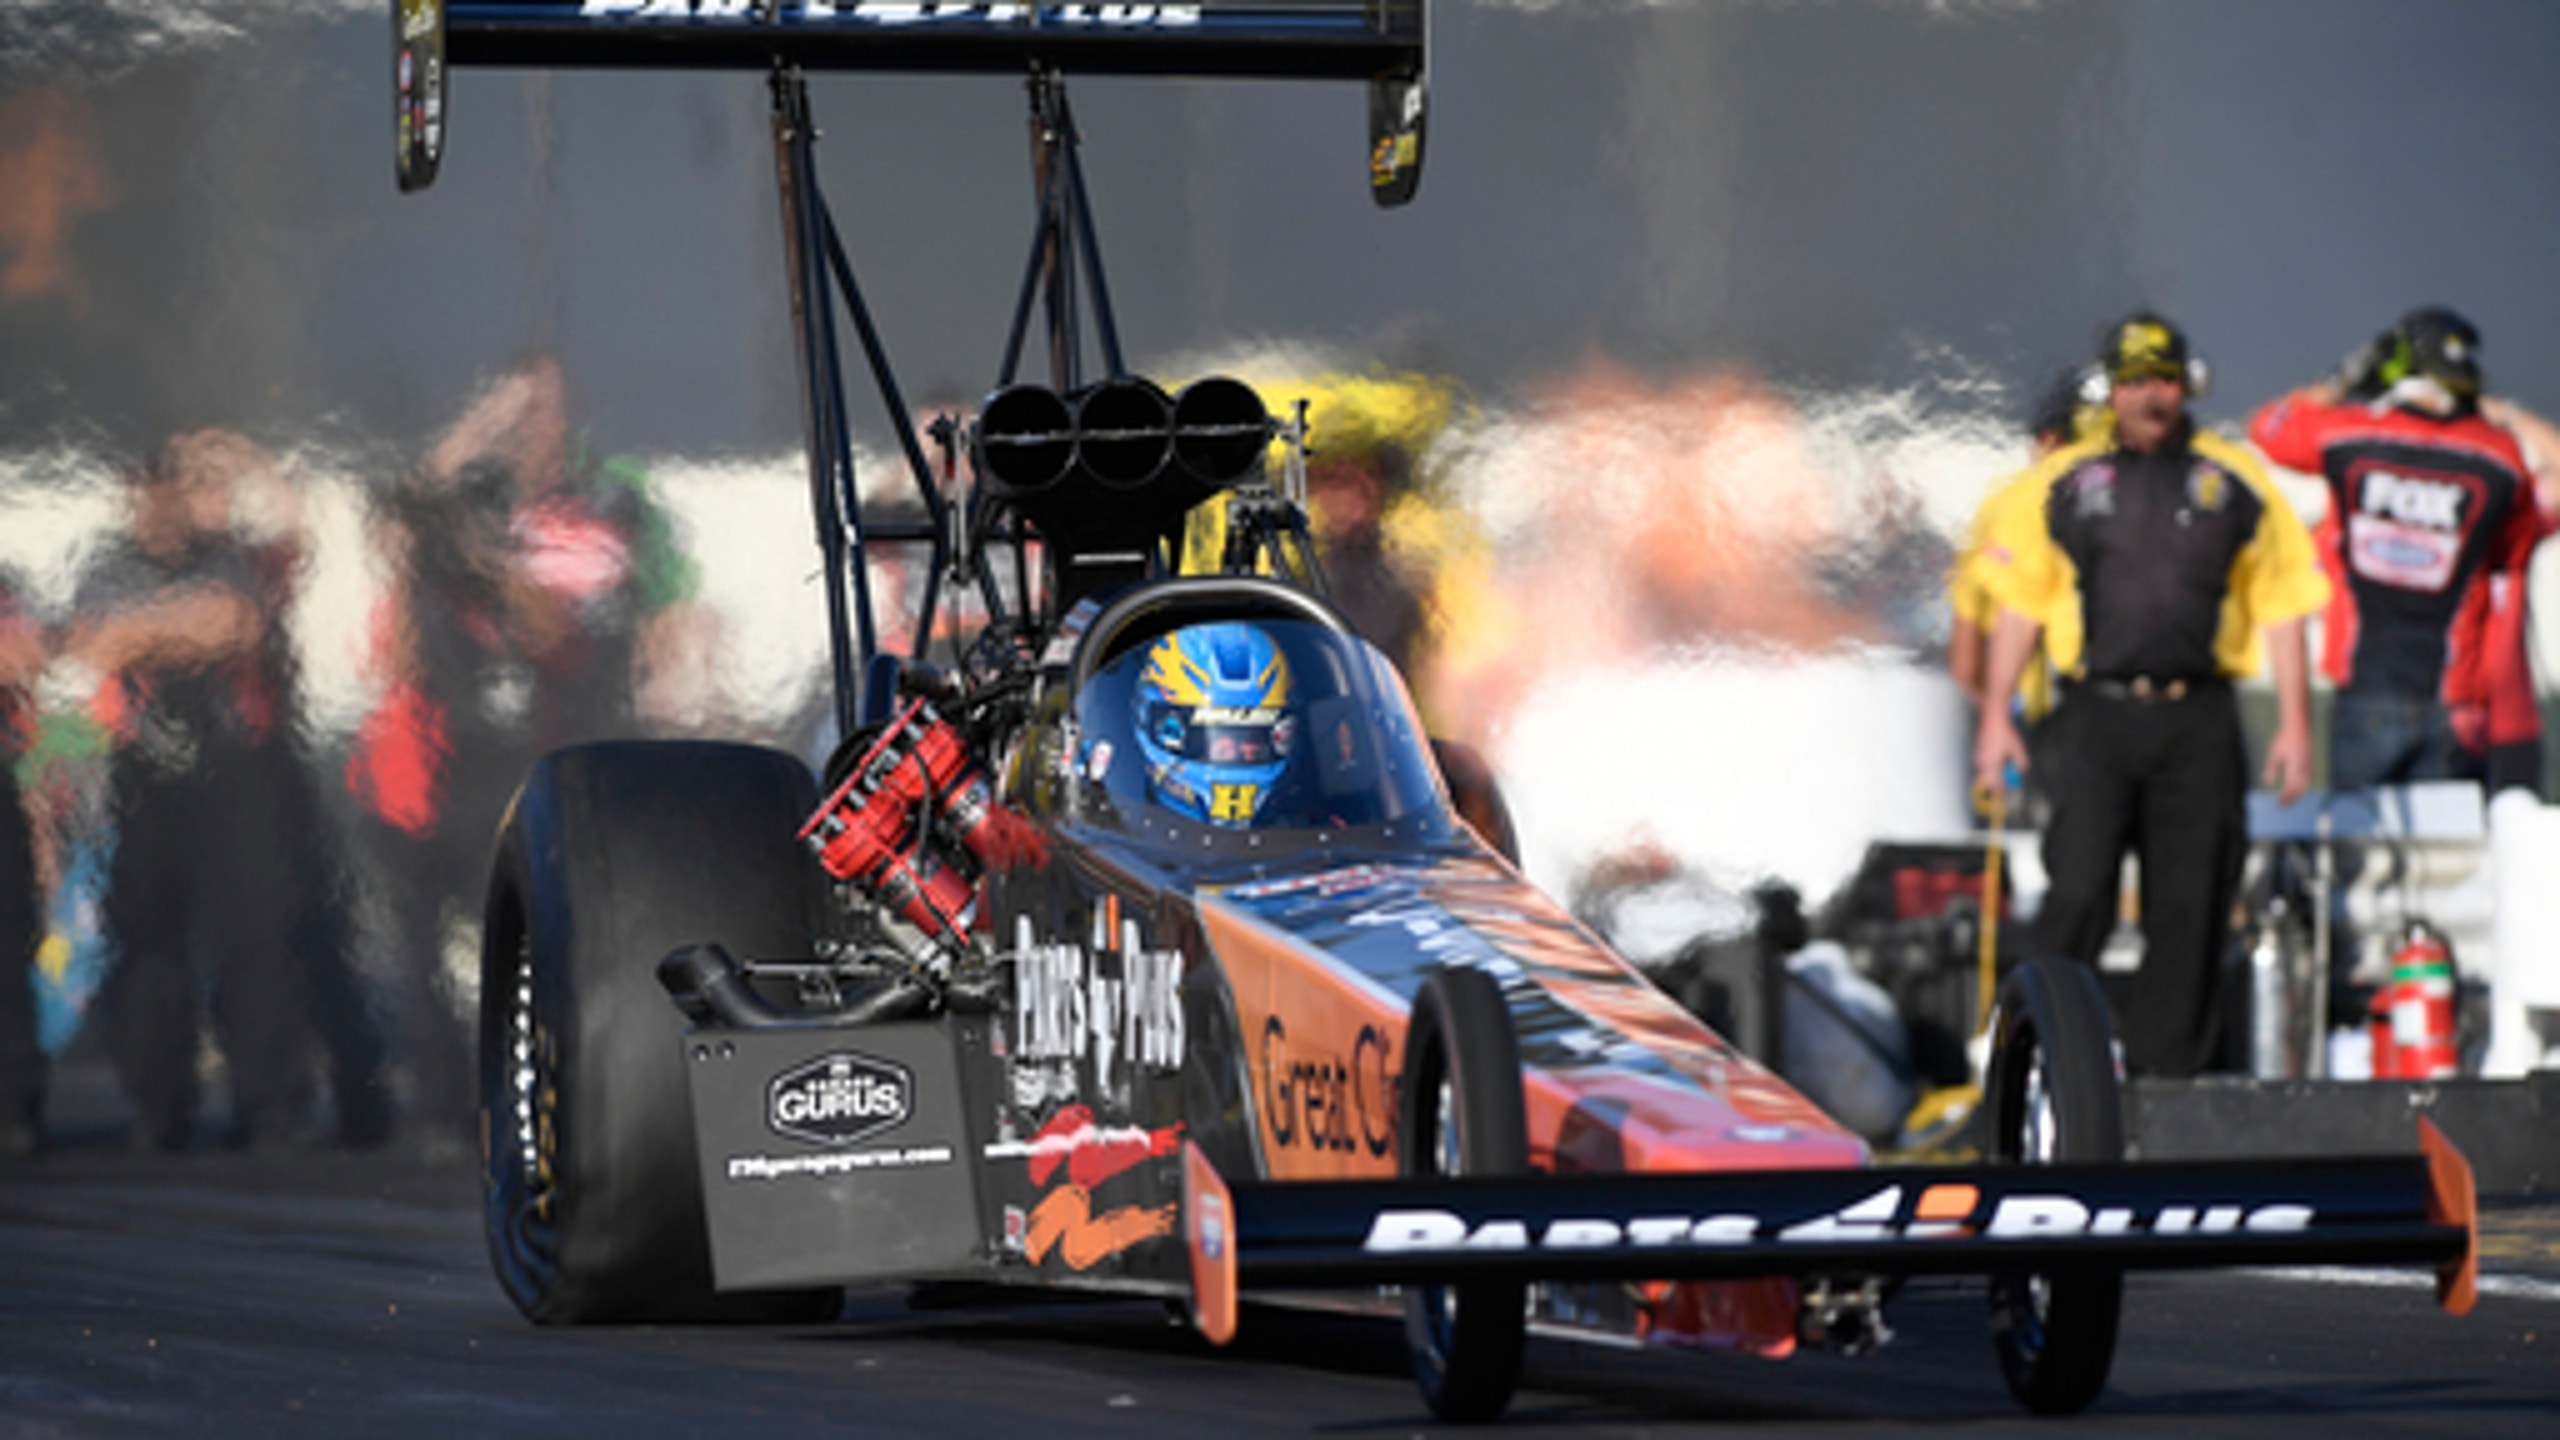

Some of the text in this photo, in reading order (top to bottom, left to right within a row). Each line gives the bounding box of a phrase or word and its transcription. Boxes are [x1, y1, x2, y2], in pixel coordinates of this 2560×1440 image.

[2363, 470, 2466, 530] FOX
[778, 1084, 900, 1121] GURUS
[1265, 1014, 1356, 1154] Great
[1364, 1195, 2316, 1251] PARTS PLUS
